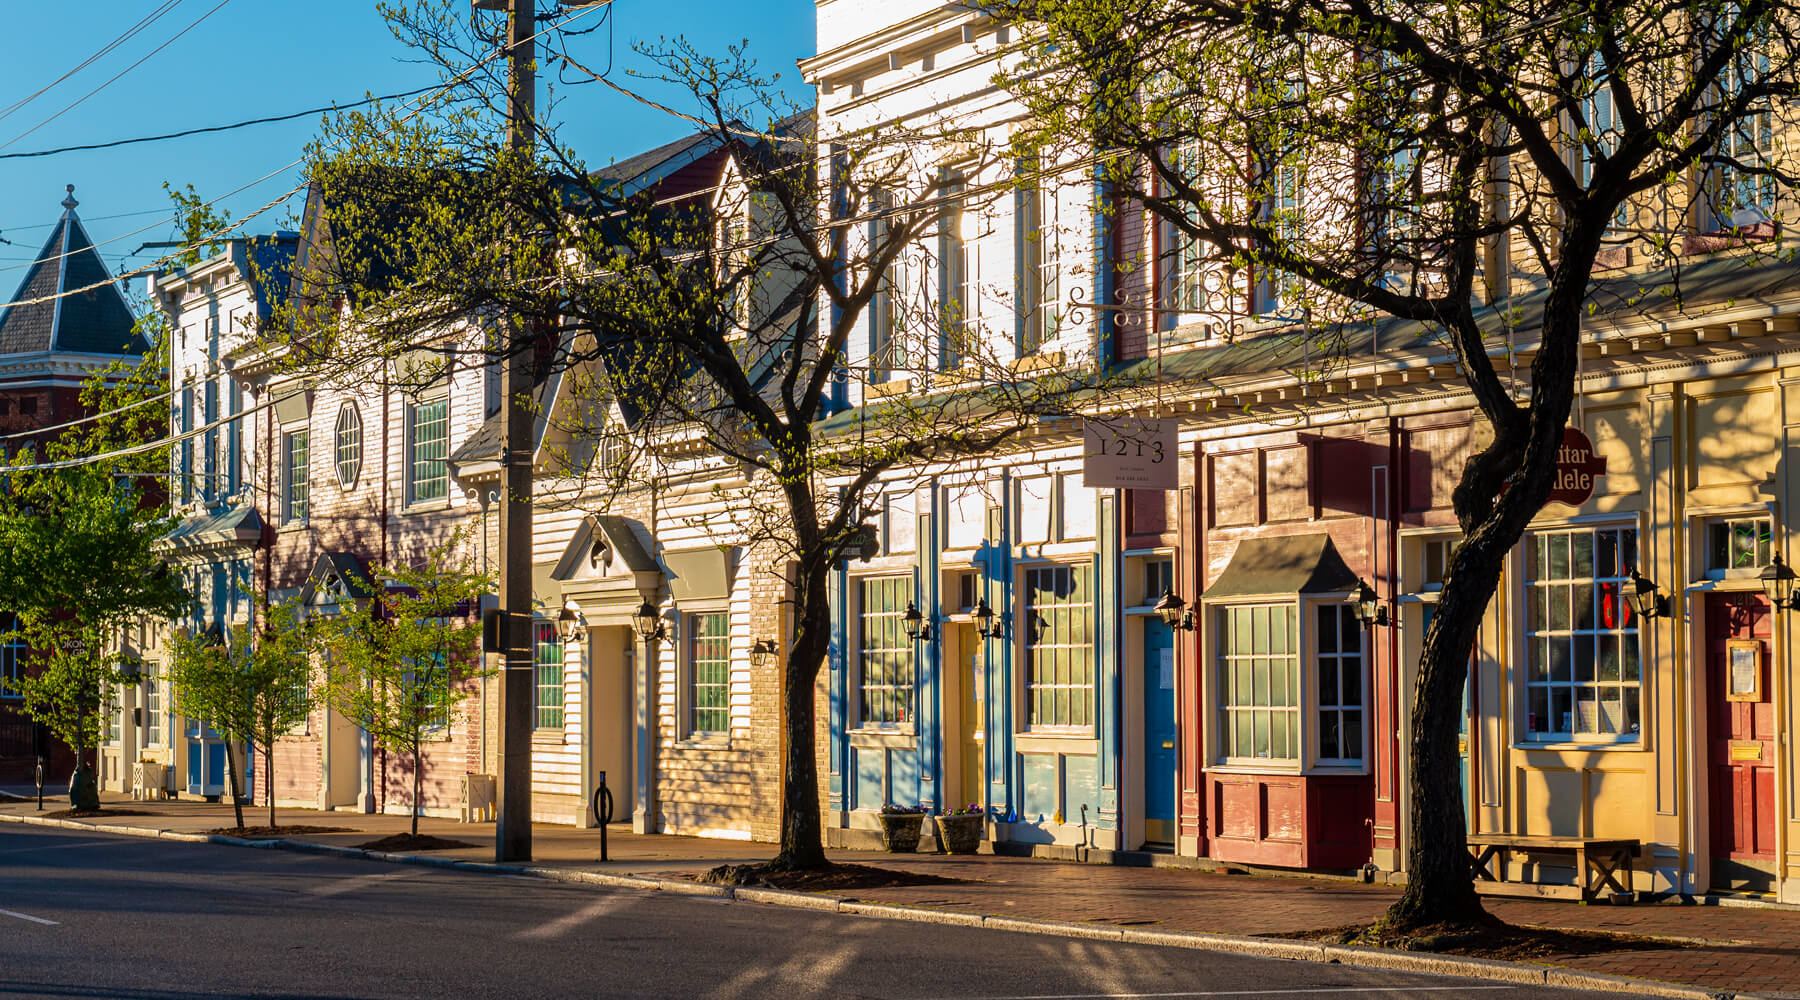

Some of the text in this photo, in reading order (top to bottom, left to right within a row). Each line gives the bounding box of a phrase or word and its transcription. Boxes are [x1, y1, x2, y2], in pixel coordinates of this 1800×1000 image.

[1099, 438, 1165, 464] 1213
[1555, 445, 1590, 464] itar
[1552, 468, 1591, 490] lele
